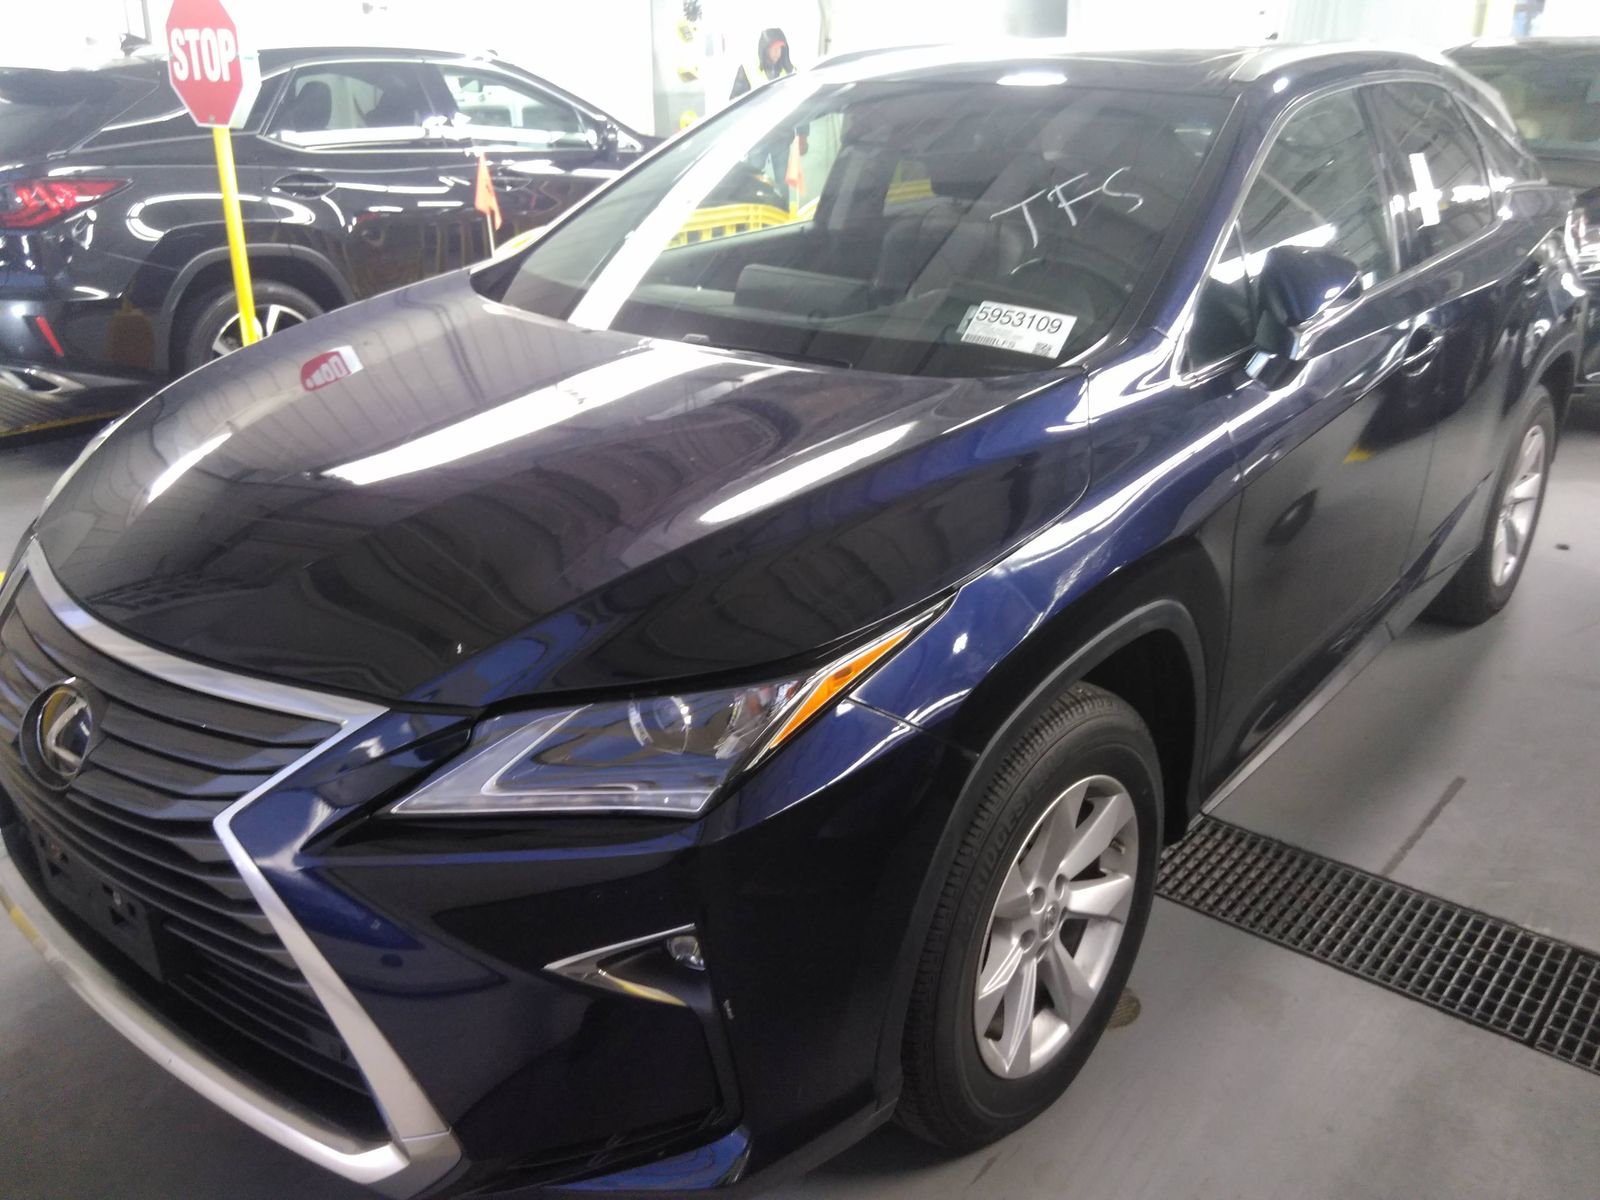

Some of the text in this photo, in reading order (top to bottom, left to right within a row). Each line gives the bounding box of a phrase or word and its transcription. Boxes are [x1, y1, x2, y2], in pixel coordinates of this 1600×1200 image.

[171, 27, 236, 82] STOP
[990, 166, 1144, 248] TFS
[976, 306, 1062, 334] 5953109
